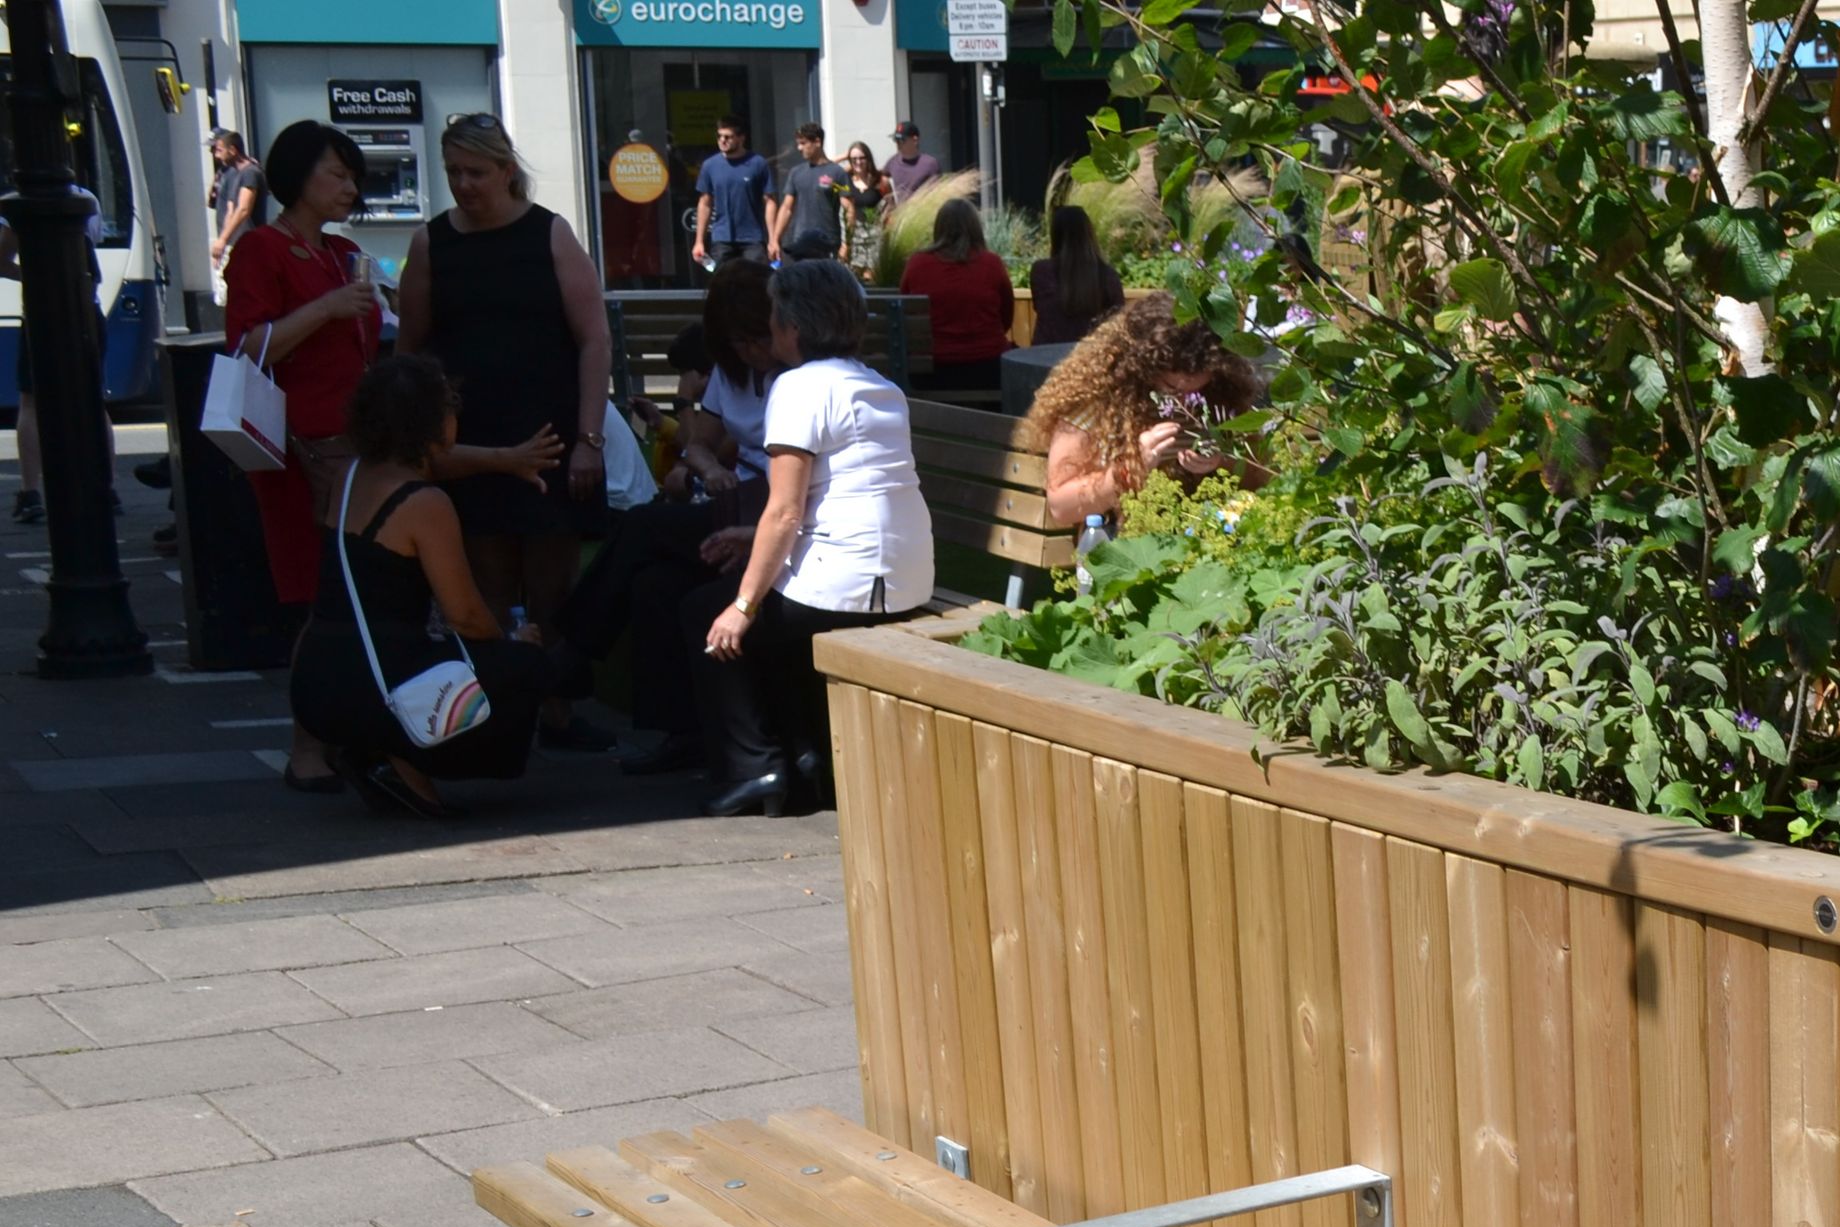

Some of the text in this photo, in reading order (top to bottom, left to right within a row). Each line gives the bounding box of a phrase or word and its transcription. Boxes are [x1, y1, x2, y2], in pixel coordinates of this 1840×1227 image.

[955, 2, 997, 11] Except buses
[631, 0, 805, 29] eurochange
[951, 12, 1002, 21] Delivery vehicles
[957, 39, 998, 49] CAUTION
[332, 87, 416, 103] Free Cash
[338, 103, 411, 115] withdrawals
[618, 152, 657, 163] PRICE
[616, 164, 661, 175] MATCH
[426, 680, 453, 737] hello sunshine
